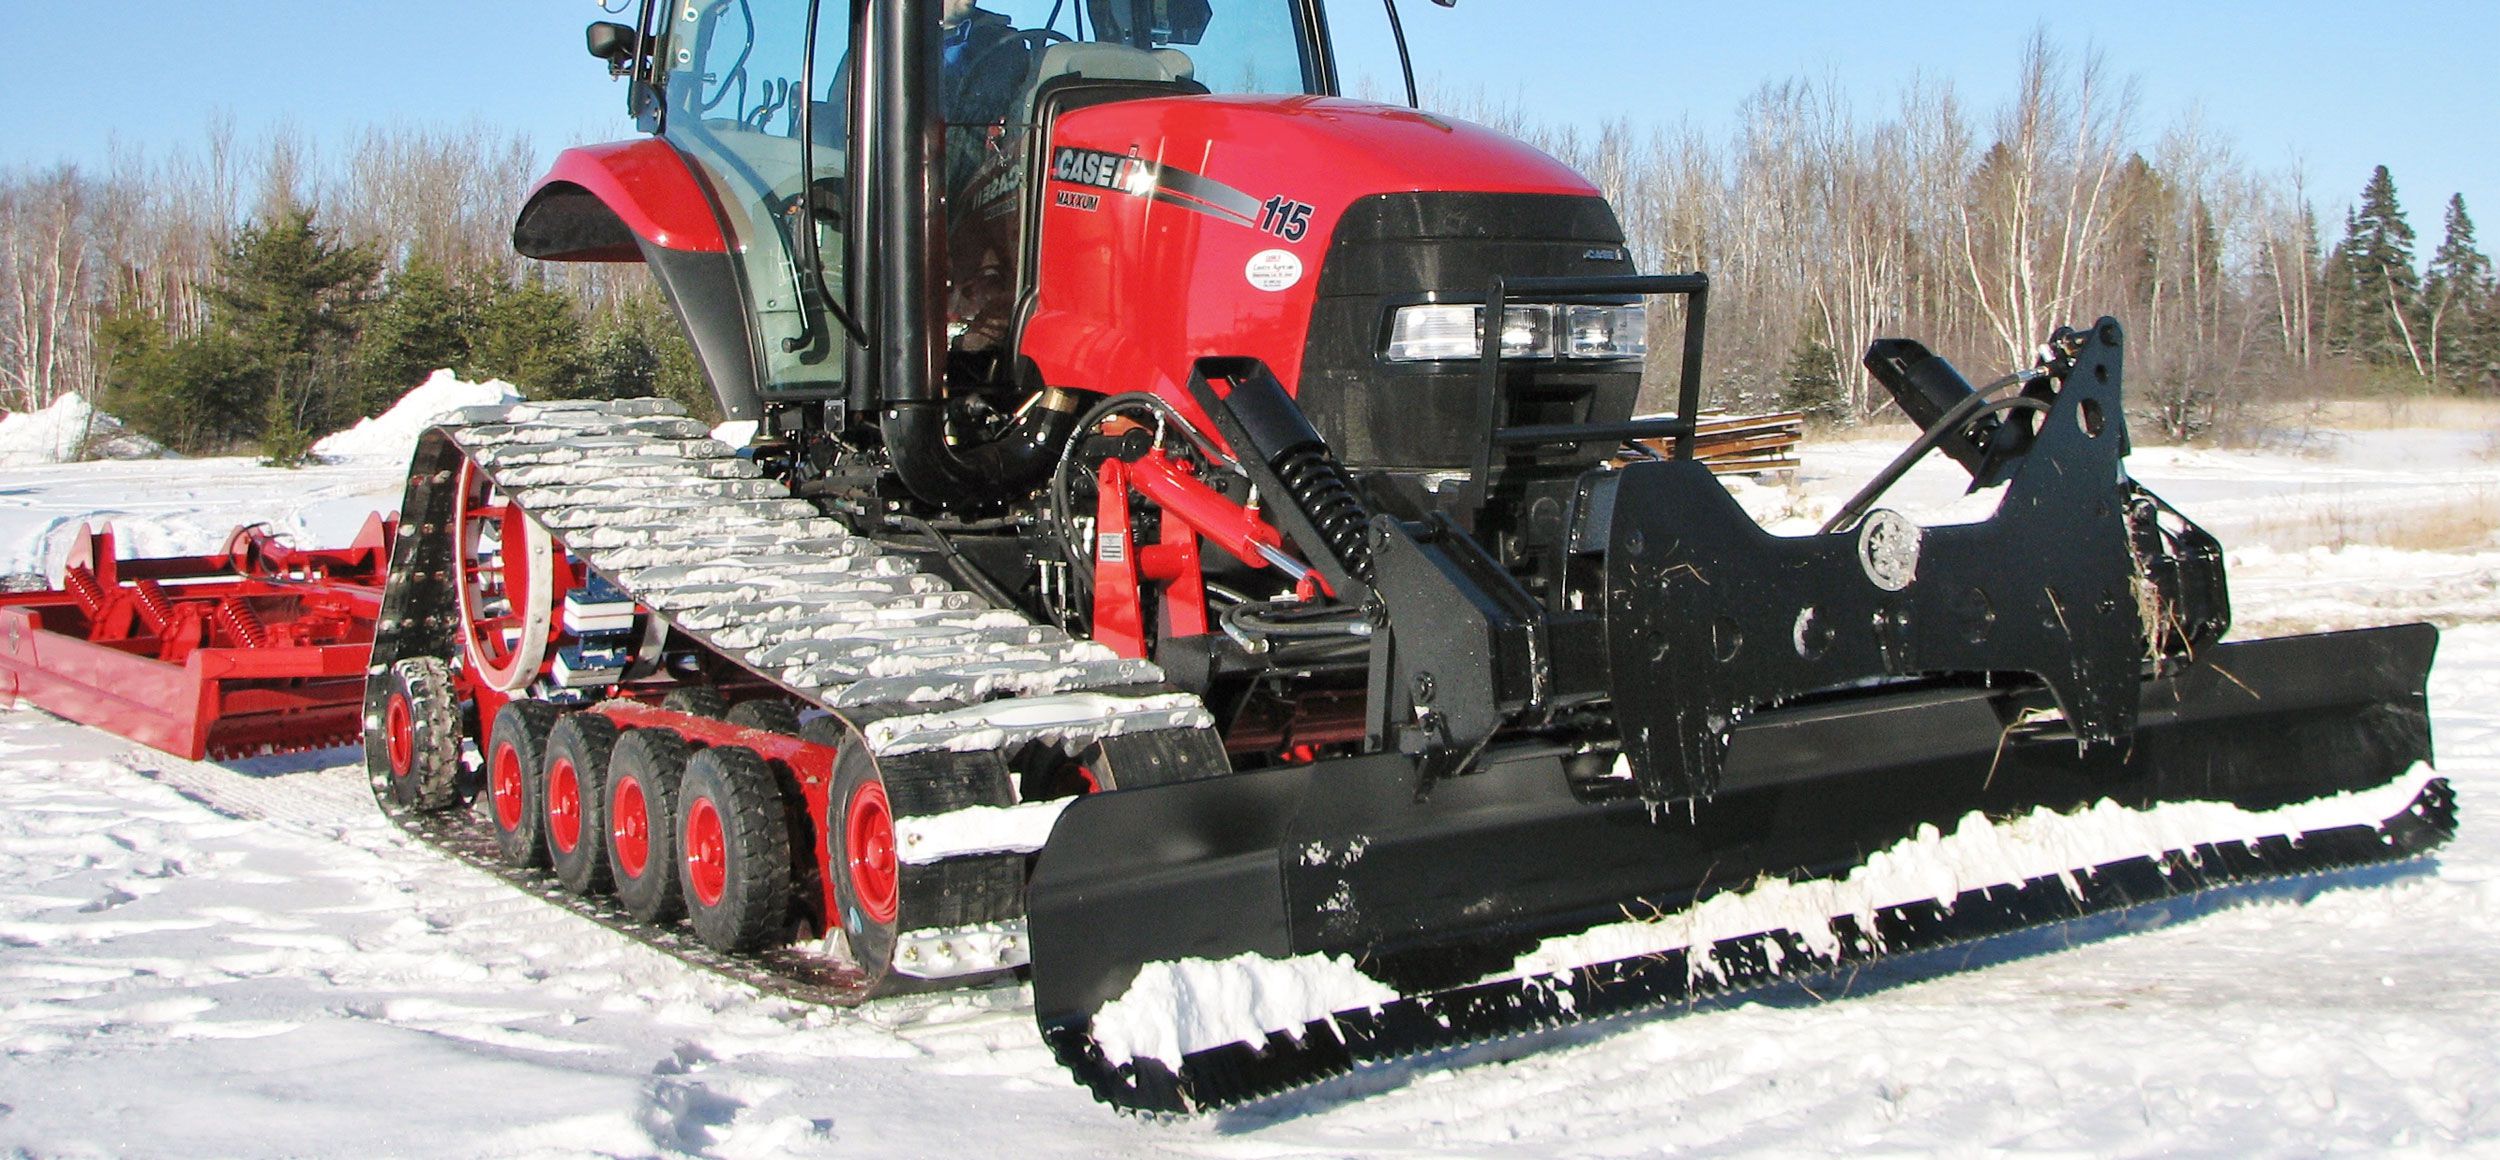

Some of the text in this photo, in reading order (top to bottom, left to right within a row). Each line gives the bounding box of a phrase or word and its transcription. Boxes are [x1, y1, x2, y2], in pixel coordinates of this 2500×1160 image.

[1058, 148, 1116, 187] CASE
[1056, 191, 1099, 210] MAXXUM
[1261, 195, 1314, 242] 115
